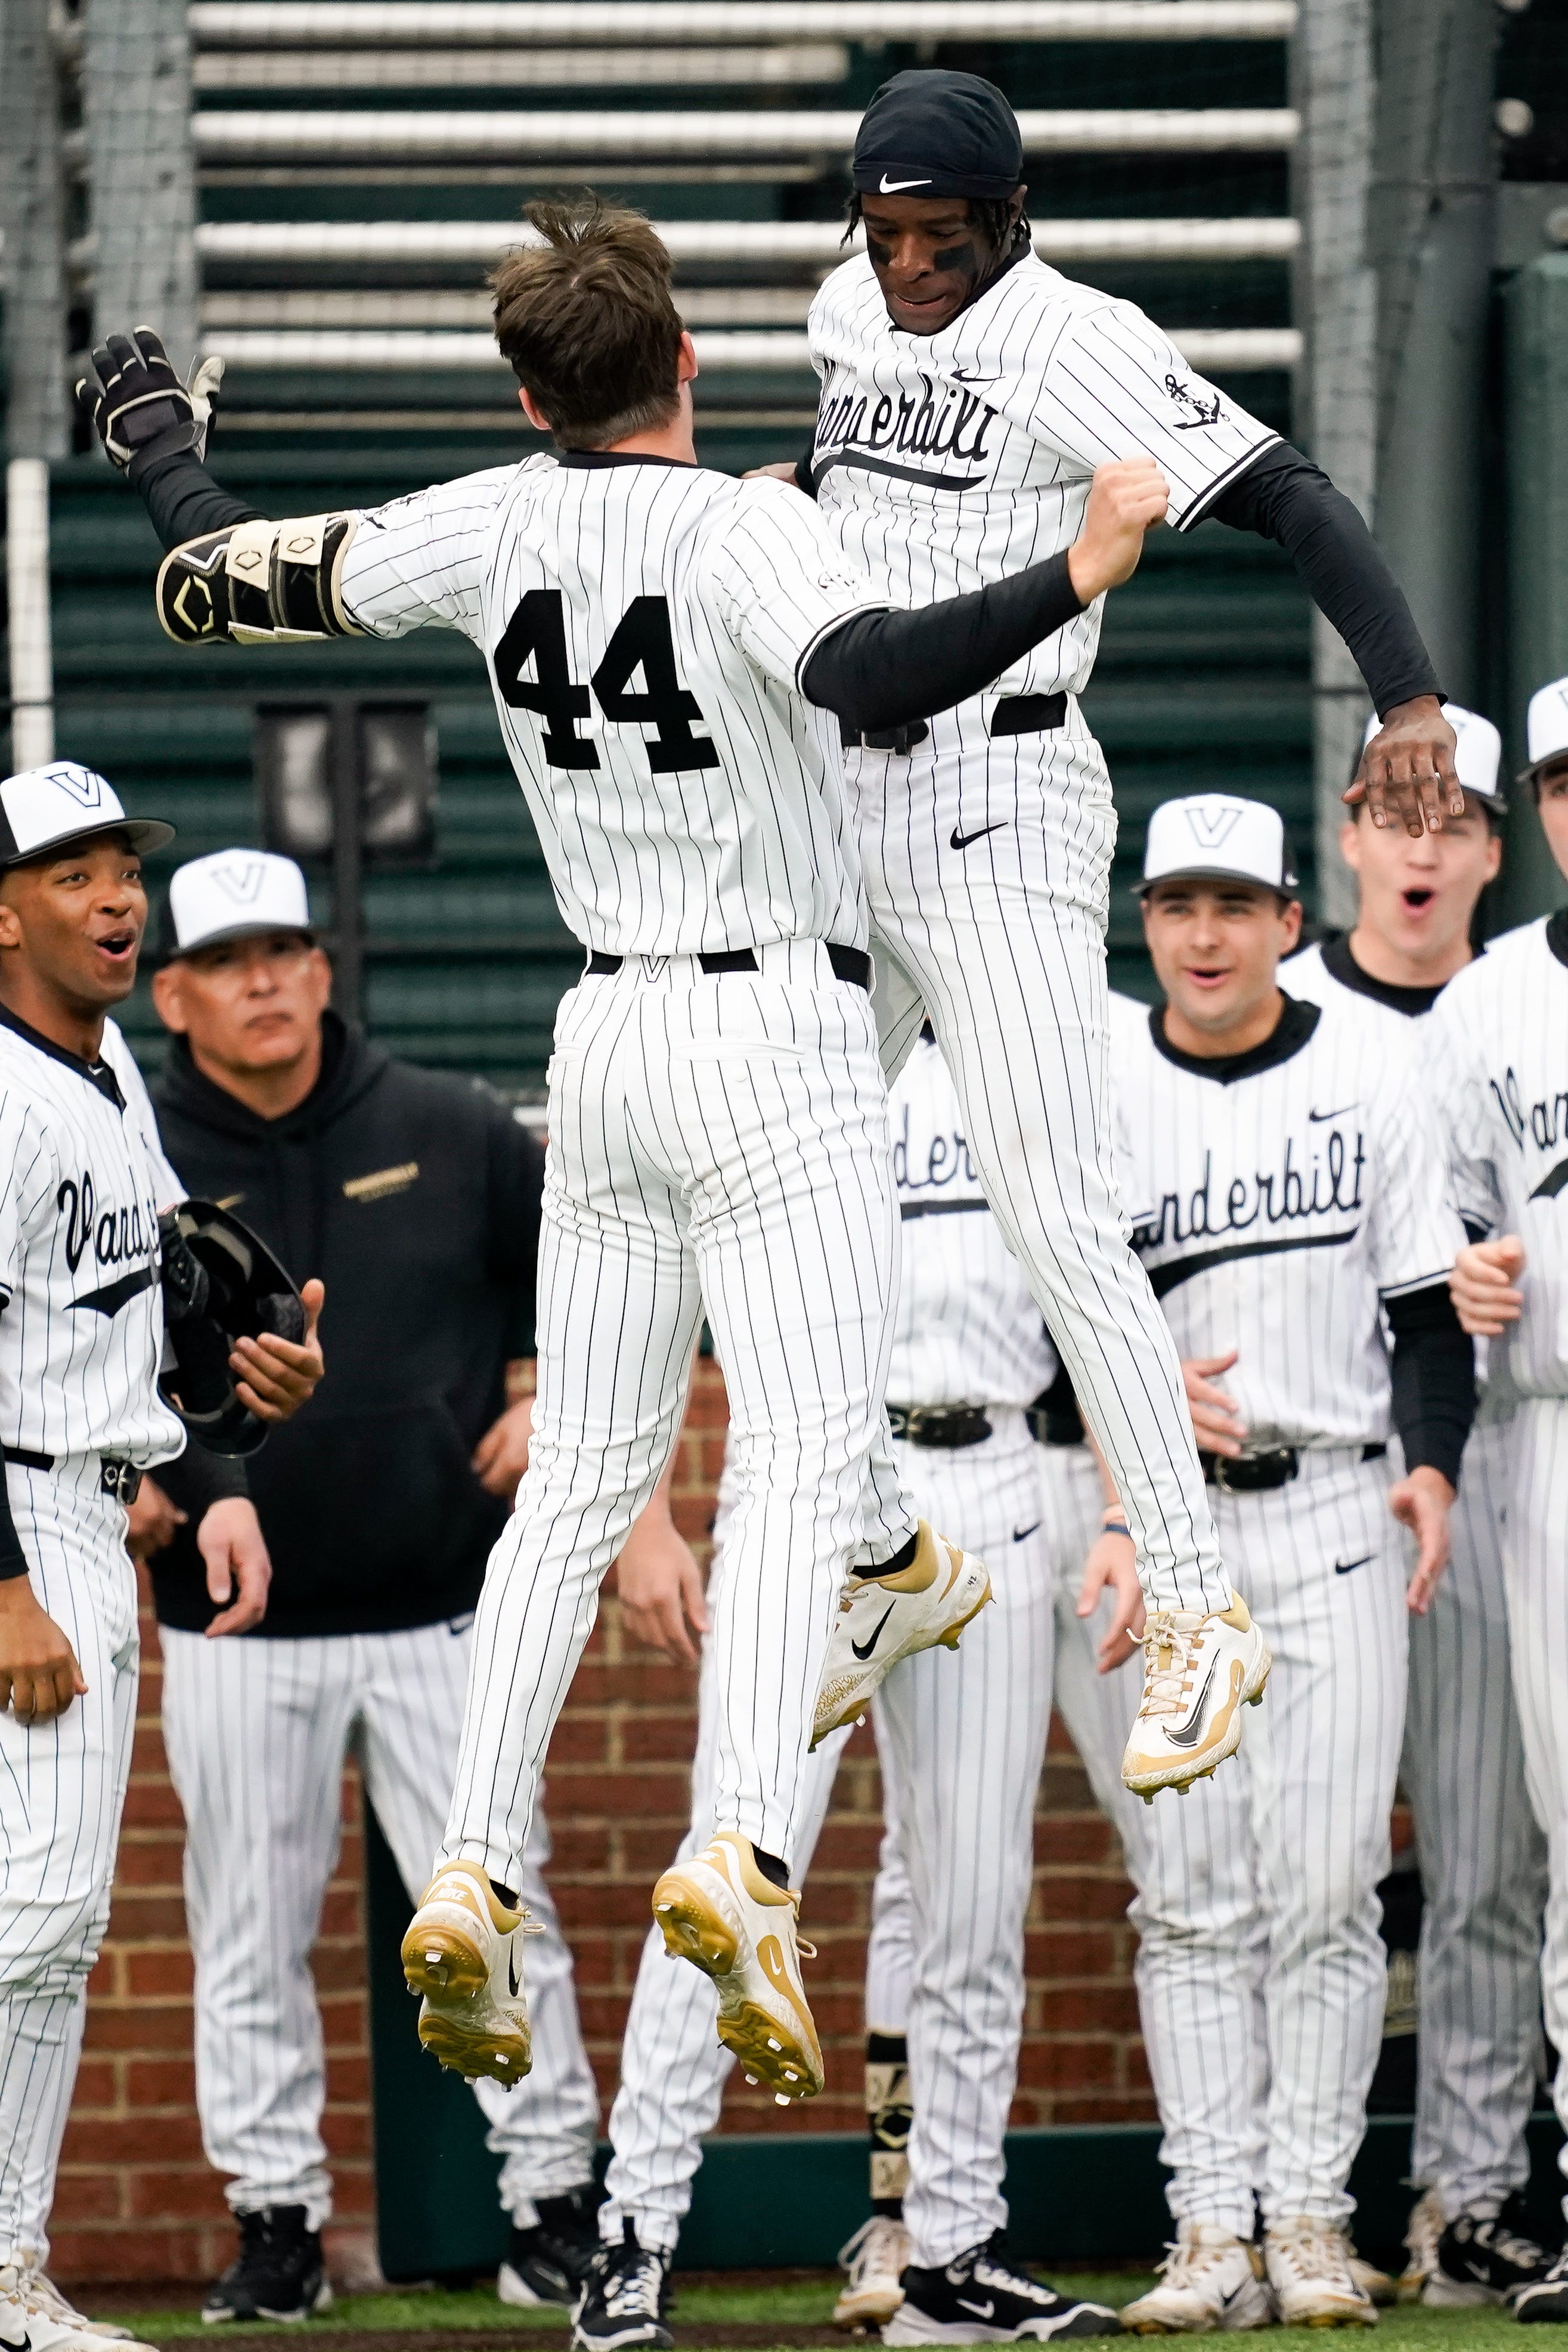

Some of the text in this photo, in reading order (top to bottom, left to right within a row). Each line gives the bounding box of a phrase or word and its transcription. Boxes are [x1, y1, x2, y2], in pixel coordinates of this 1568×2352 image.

[815, 358, 991, 462] anderbilt
[494, 589, 721, 774] 44
[44, 770, 101, 807] V
[1183, 807, 1243, 848] V
[209, 863, 267, 906] V
[639, 954, 671, 983] V
[1130, 1130, 1366, 1252] anderbilt
